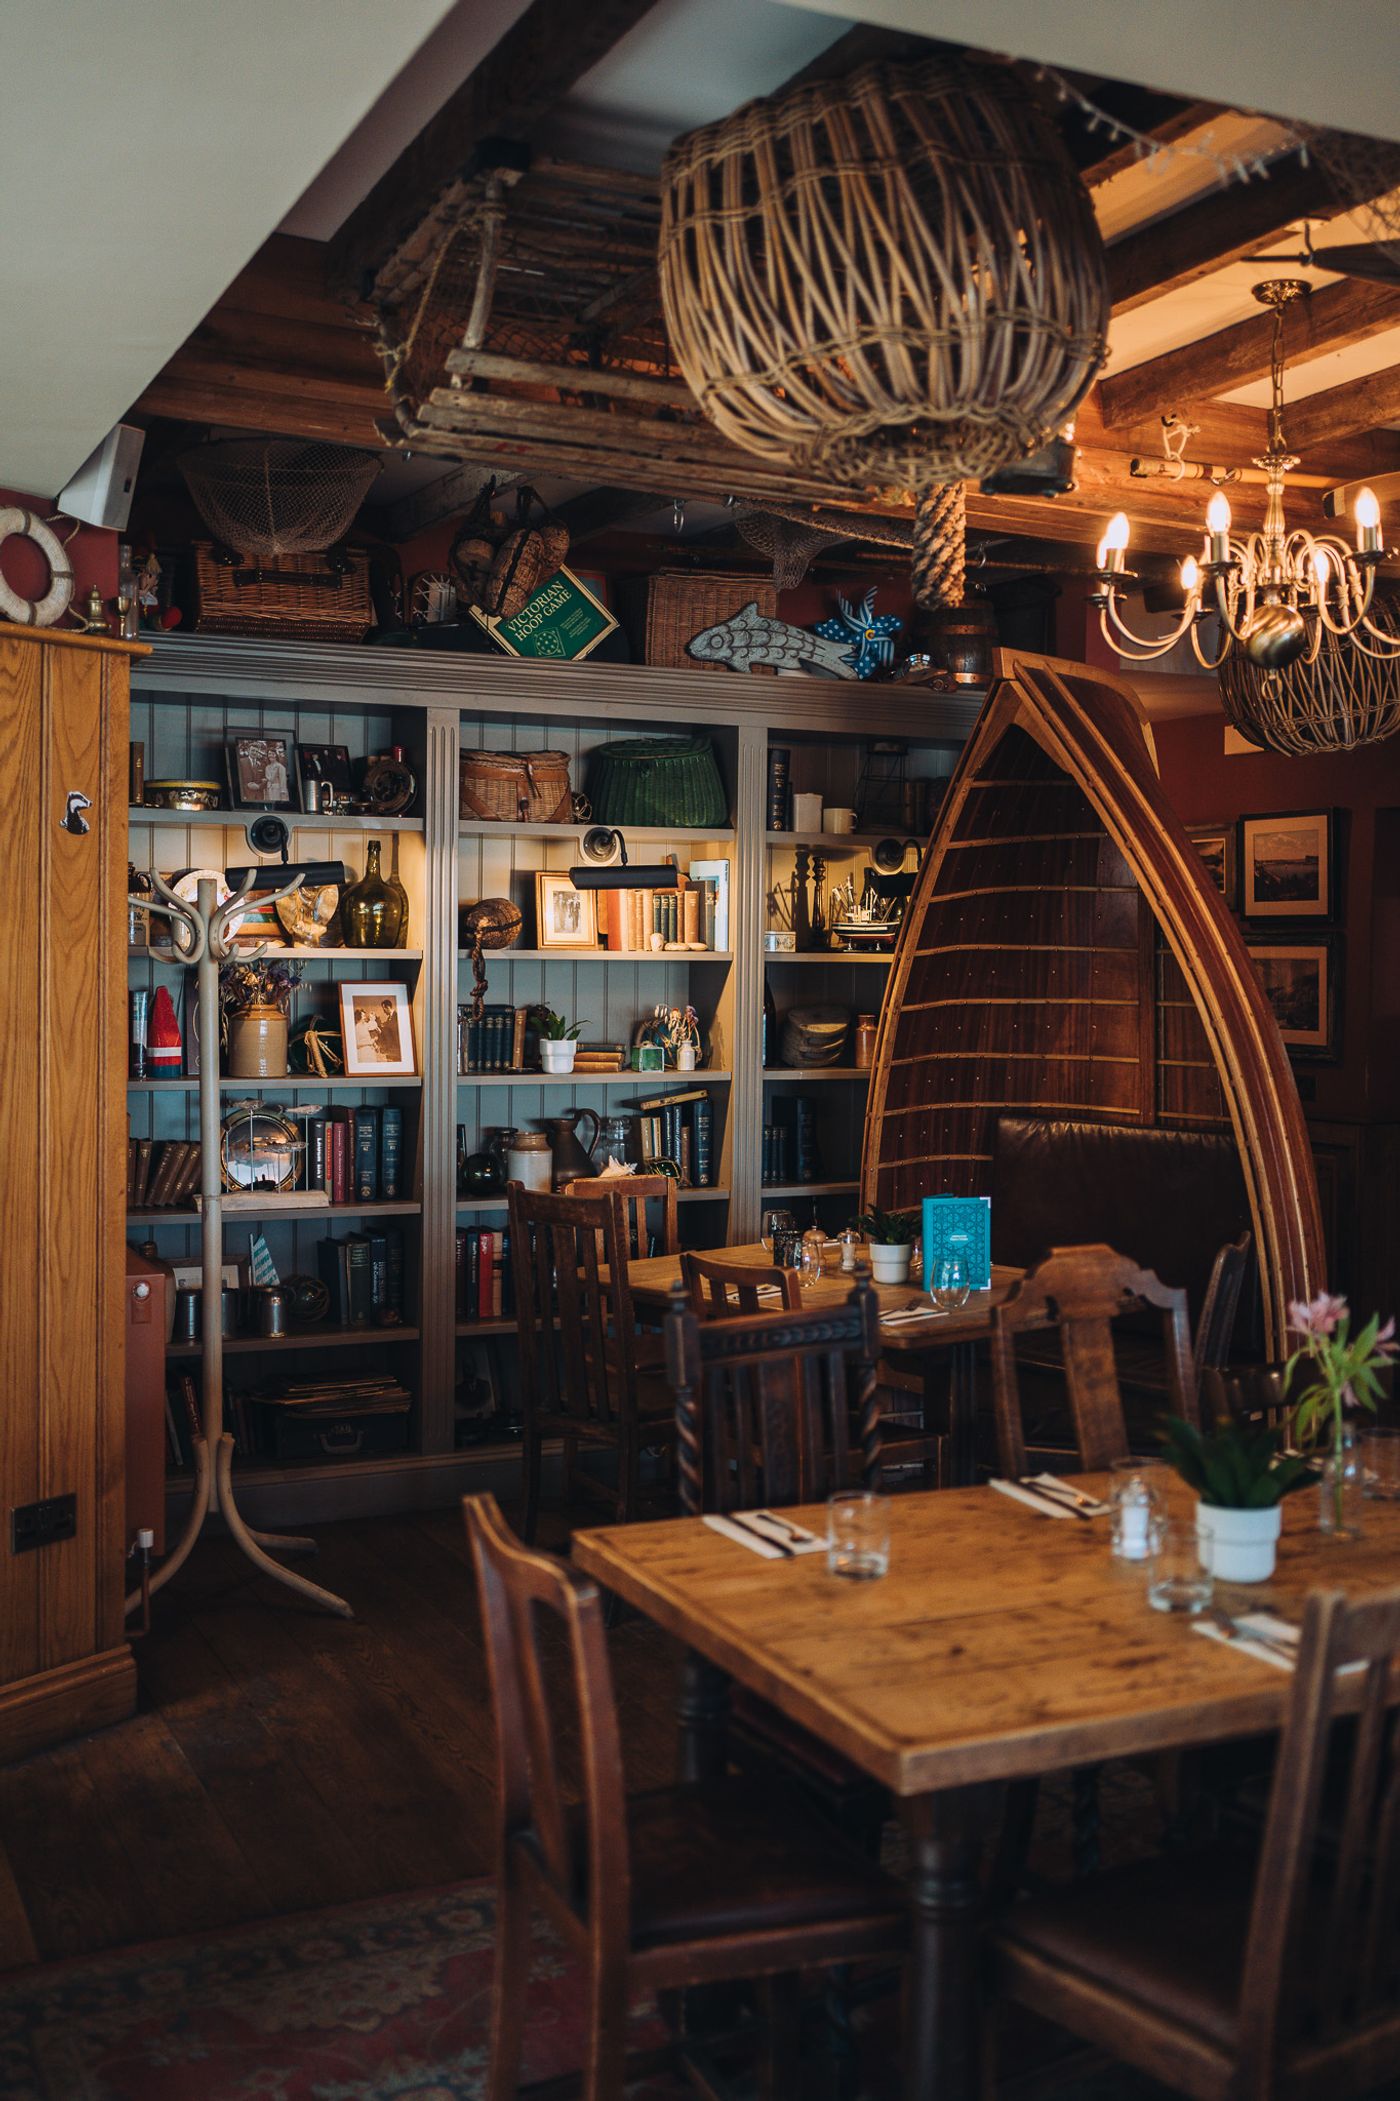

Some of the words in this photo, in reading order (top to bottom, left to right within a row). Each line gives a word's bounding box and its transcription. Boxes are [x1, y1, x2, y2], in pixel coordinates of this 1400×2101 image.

[507, 581, 565, 632] VICTORIAN
[515, 615, 544, 641] HOOP
[543, 589, 572, 617] GAME
